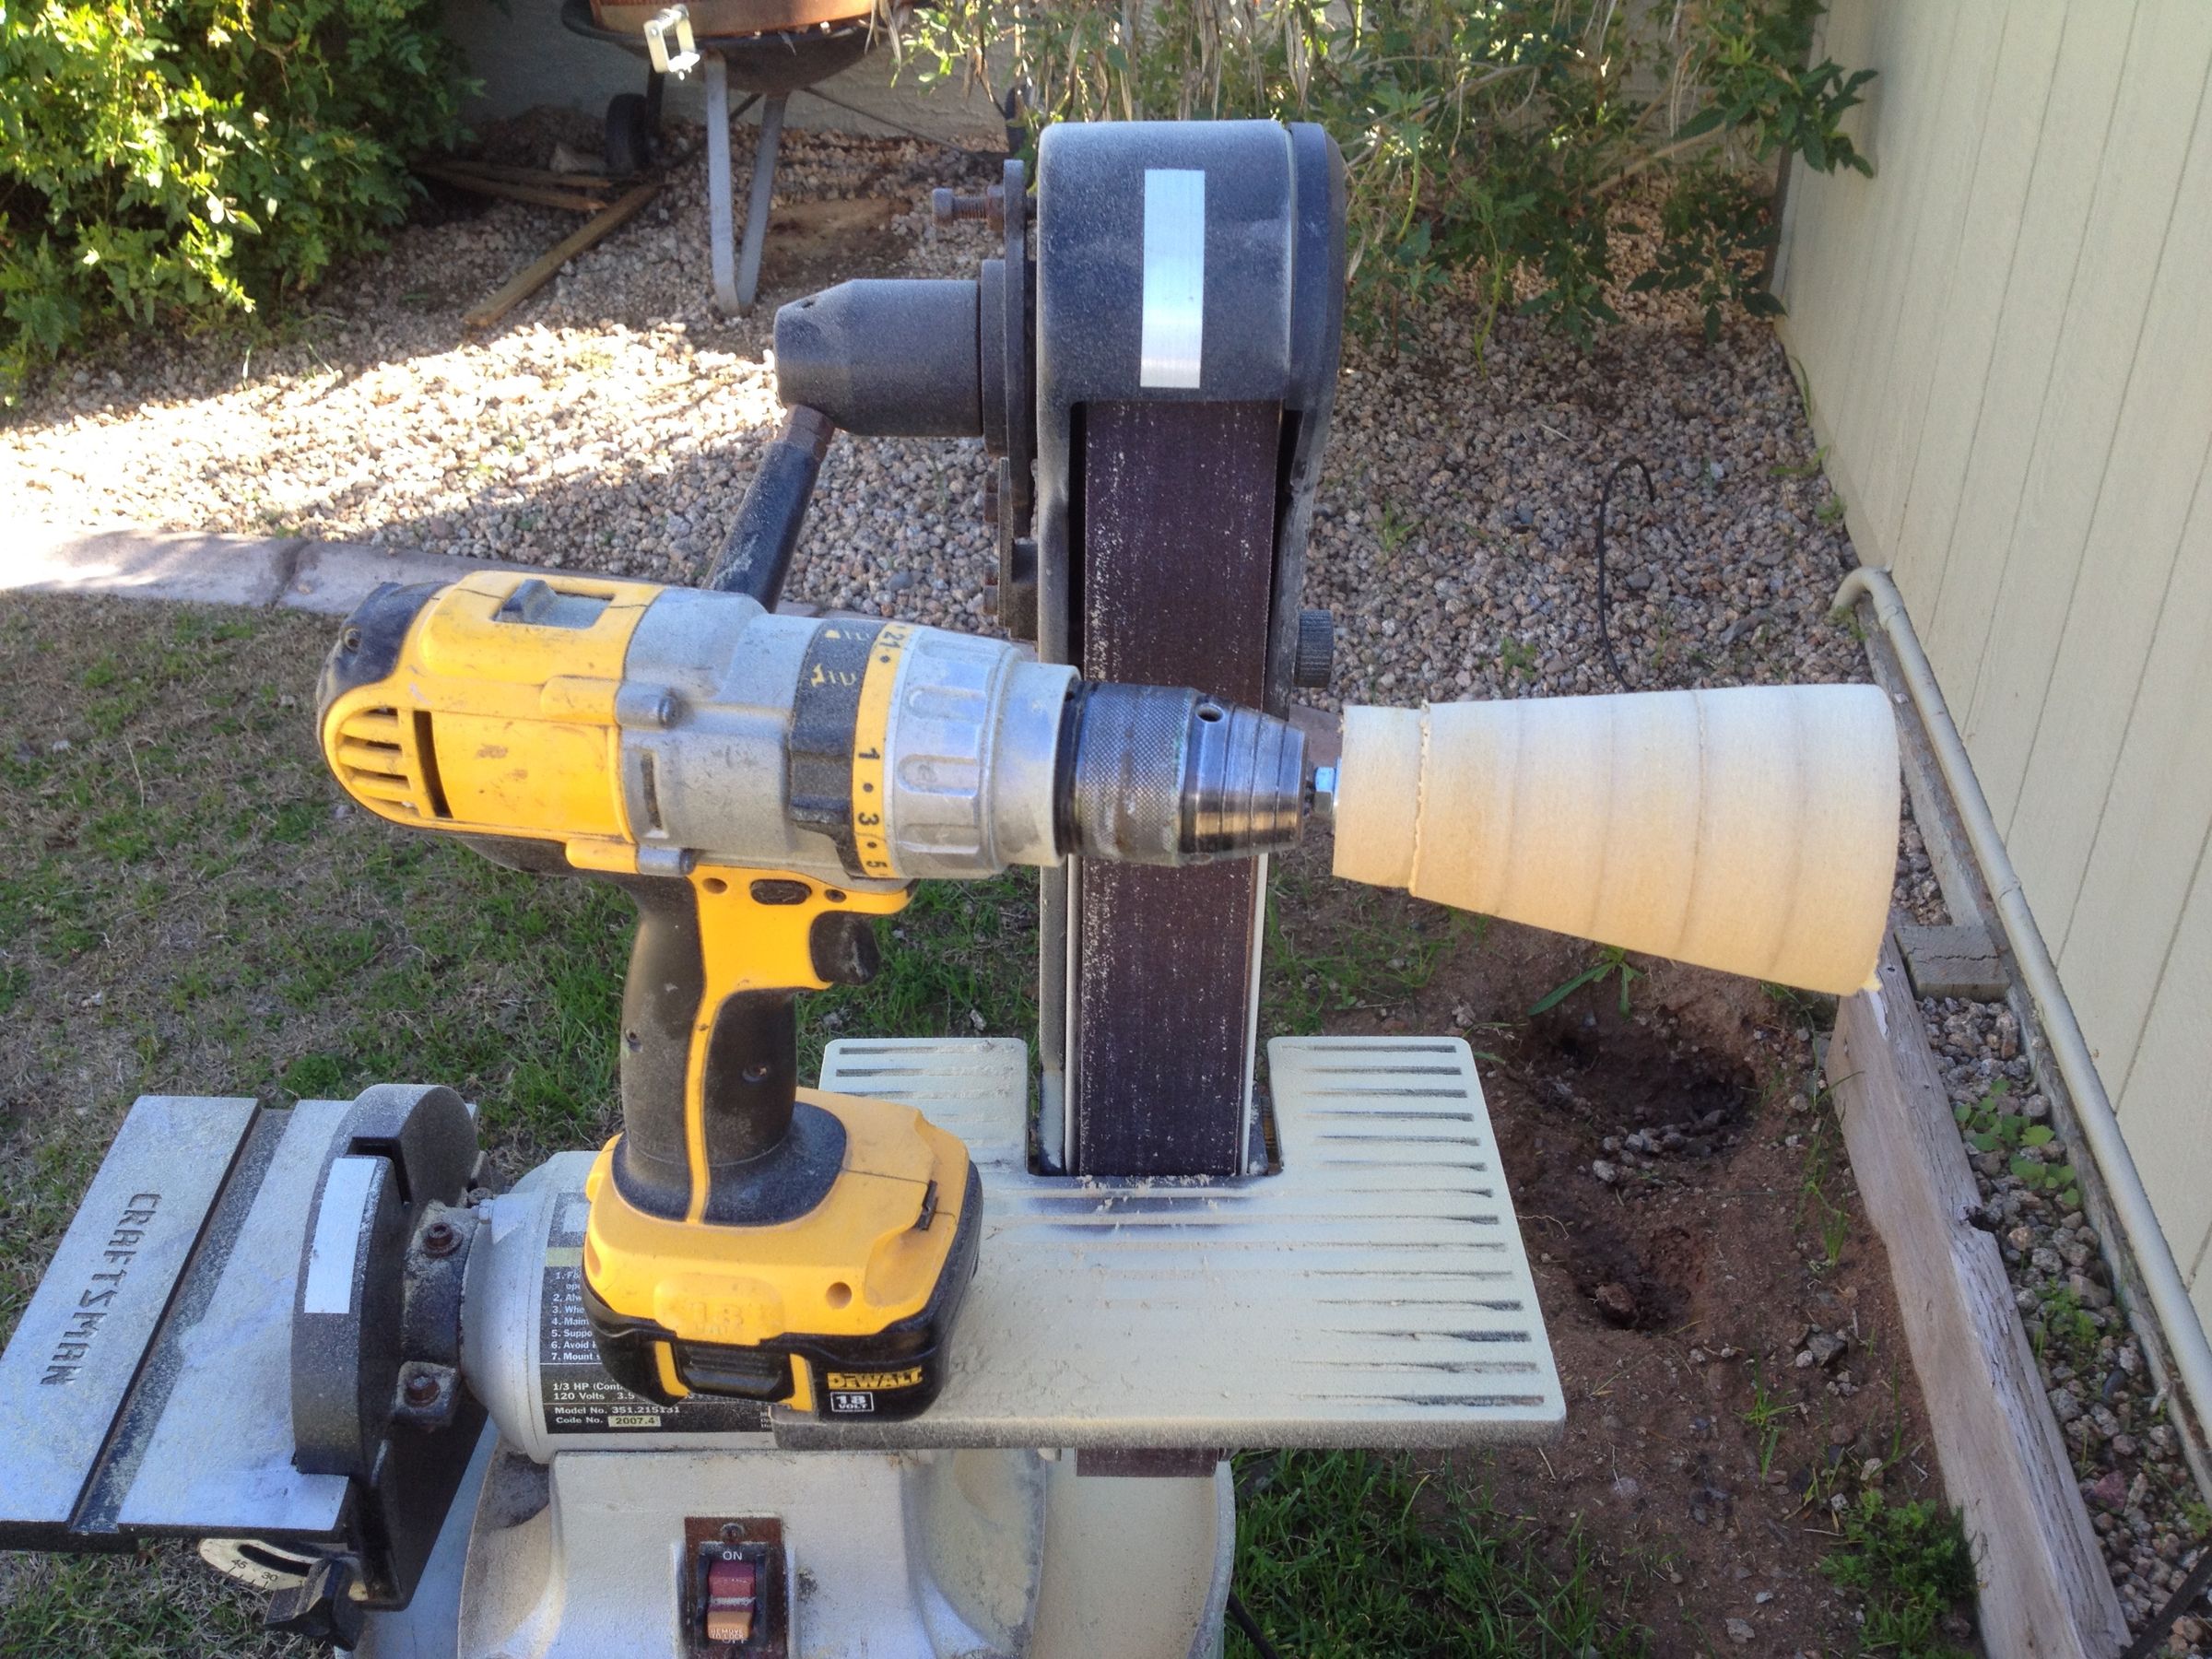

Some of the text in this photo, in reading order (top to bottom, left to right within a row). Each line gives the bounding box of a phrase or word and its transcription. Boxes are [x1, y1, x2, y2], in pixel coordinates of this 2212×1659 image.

[858, 747, 880, 760] 1
[857, 812, 880, 826] 3
[40, 1193, 162, 1384] CRAFTSMAN
[563, 1340, 590, 1349] Avoid
[563, 1352, 594, 1360] Mount
[553, 1382, 570, 1391] 1/3
[573, 1382, 590, 1391] HP
[554, 1392, 635, 1400] 120 Volts 3.5
[836, 1395, 866, 1404] 18
[555, 1406, 589, 1415] Model
[590, 1406, 607, 1415] No.
[615, 1417, 656, 1426] 2007.4
[723, 1550, 743, 1561] ON
[231, 1559, 249, 1570] 45
[261, 1571, 278, 1582] 30
